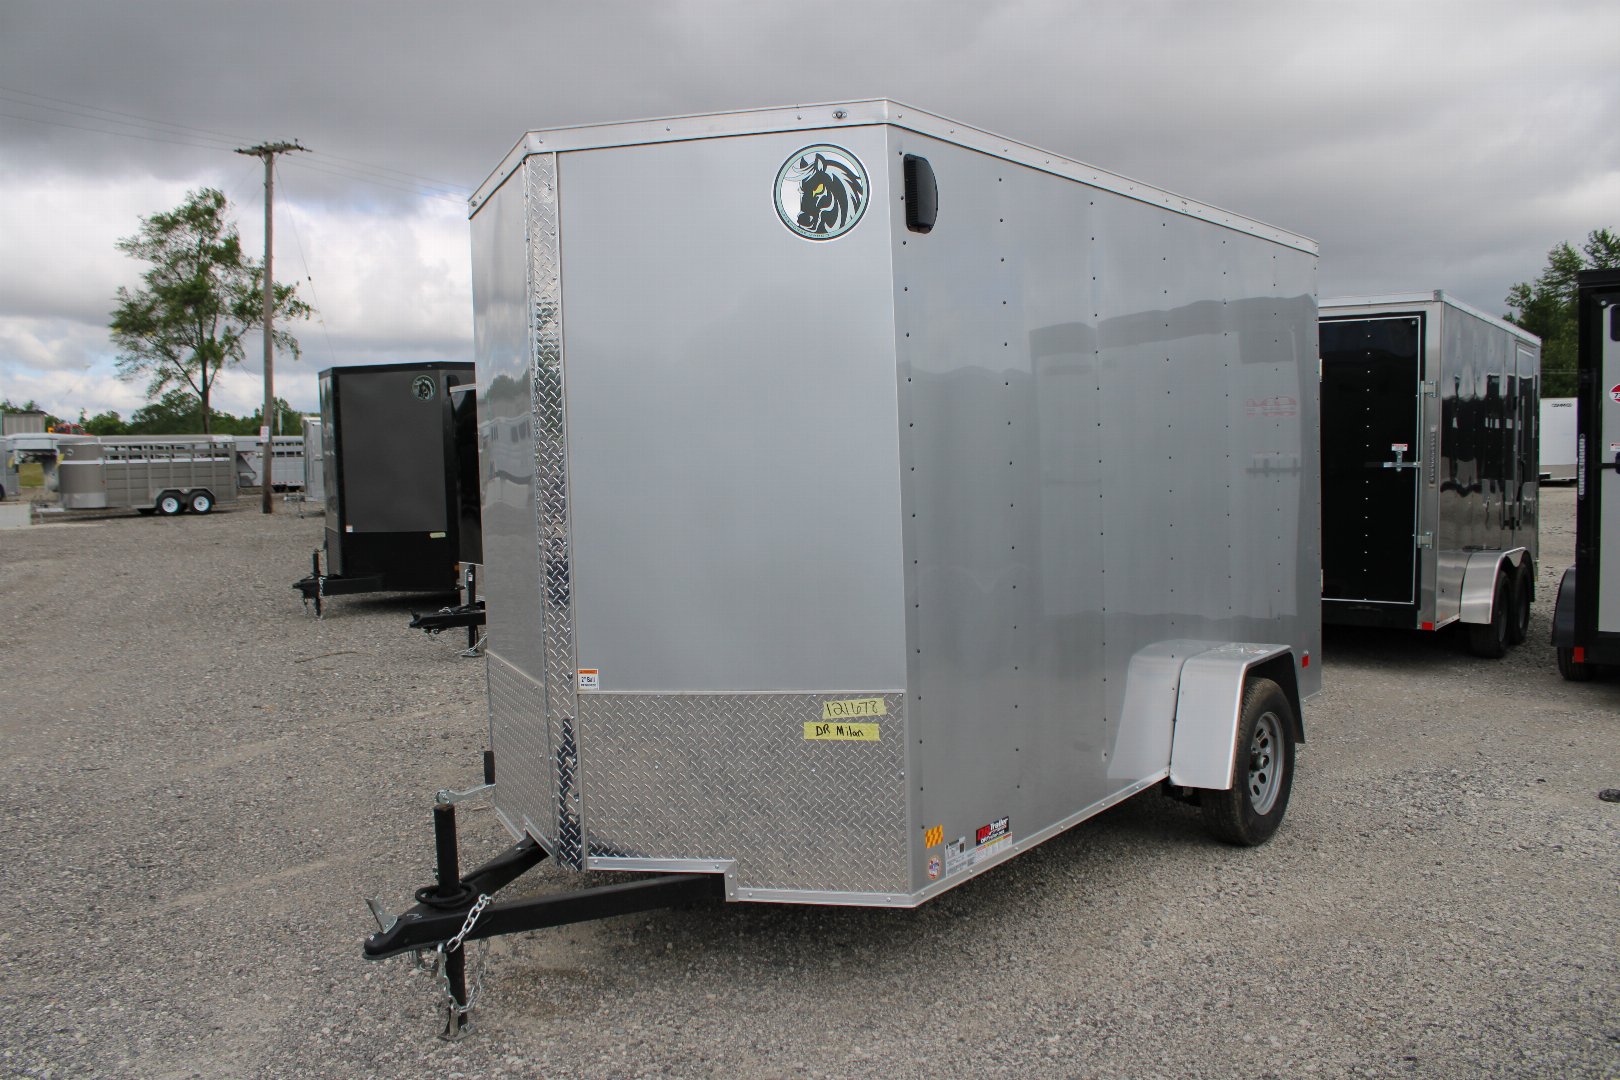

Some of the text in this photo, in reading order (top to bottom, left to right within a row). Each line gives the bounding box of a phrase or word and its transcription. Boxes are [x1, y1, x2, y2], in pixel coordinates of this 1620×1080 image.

[816, 723, 864, 737] DR Milan
[990, 817, 1009, 831] Trailer
